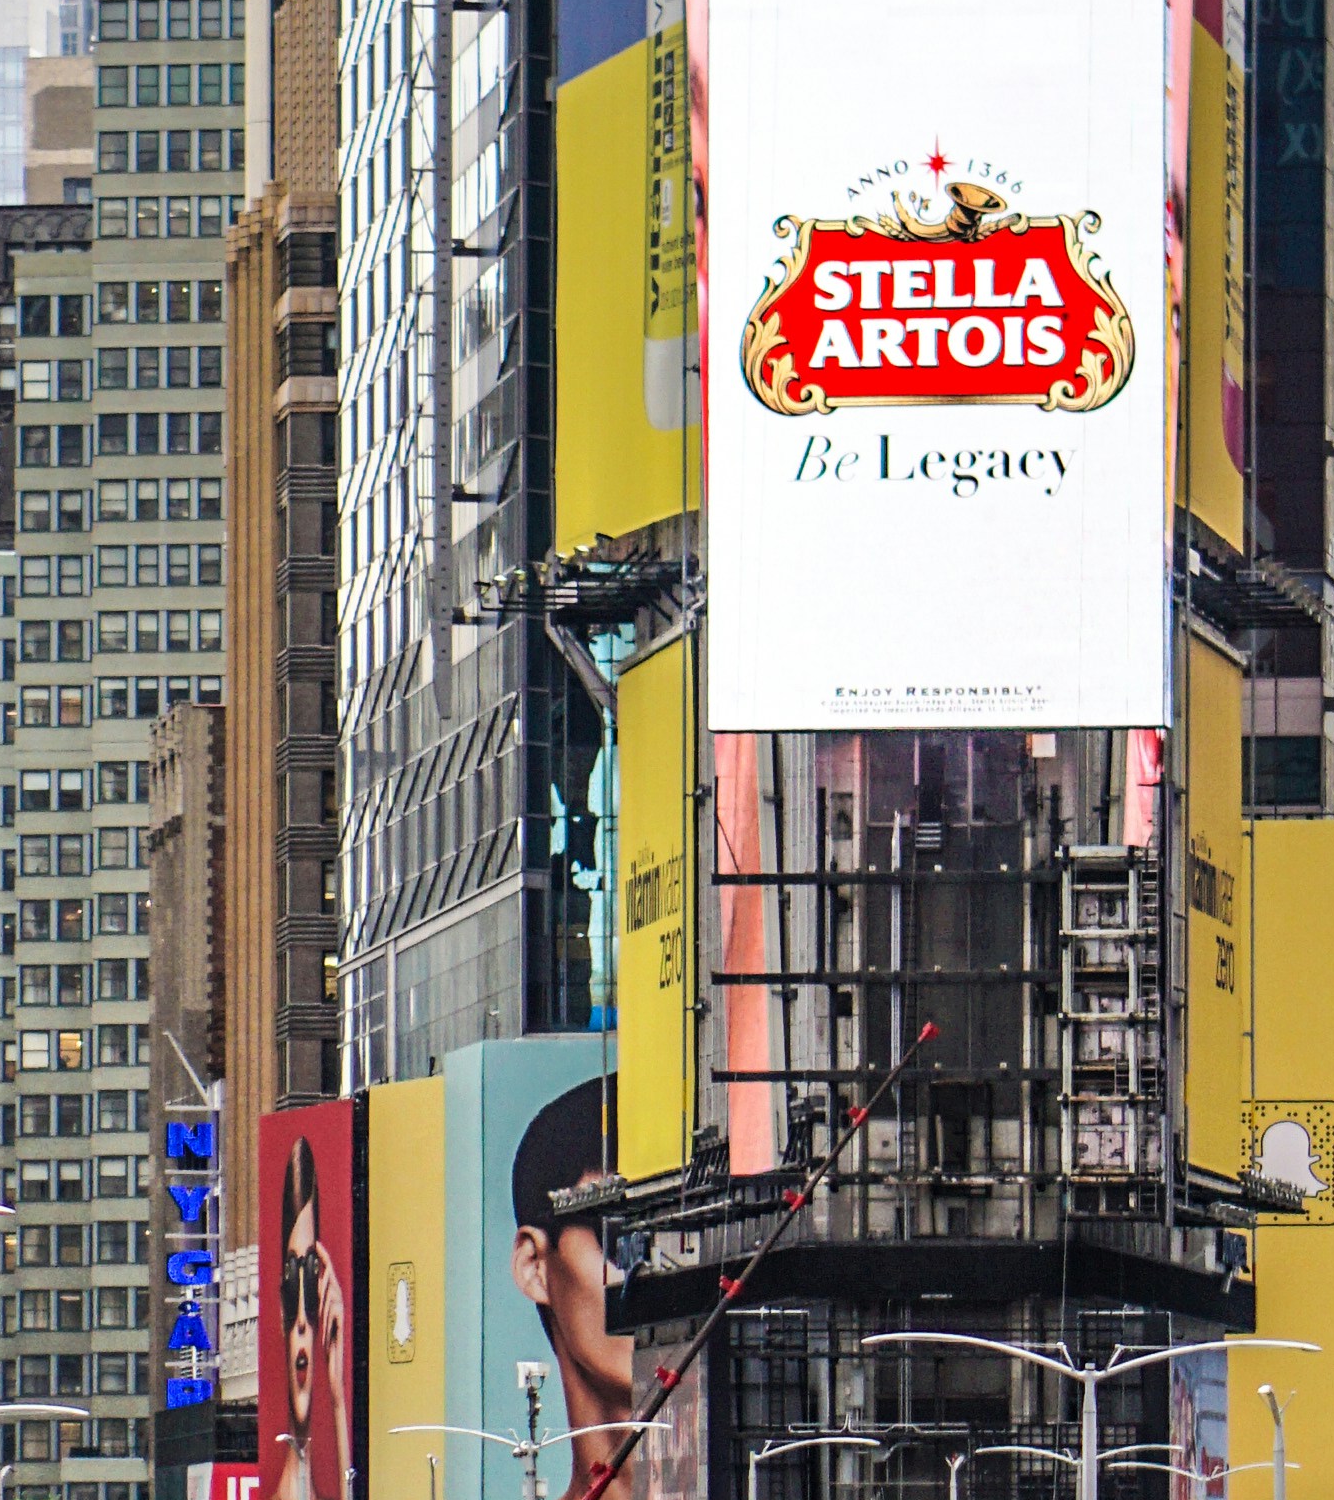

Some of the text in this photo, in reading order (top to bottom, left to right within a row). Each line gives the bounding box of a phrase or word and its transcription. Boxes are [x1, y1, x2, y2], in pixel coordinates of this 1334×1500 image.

[844, 158, 1025, 201] ANNO 1366
[812, 258, 1066, 311] STELLA
[807, 315, 1068, 370] ARTOIS
[793, 433, 1078, 499] Be Legacy
[835, 686, 895, 698] ENJOY
[659, 926, 683, 990] zero
